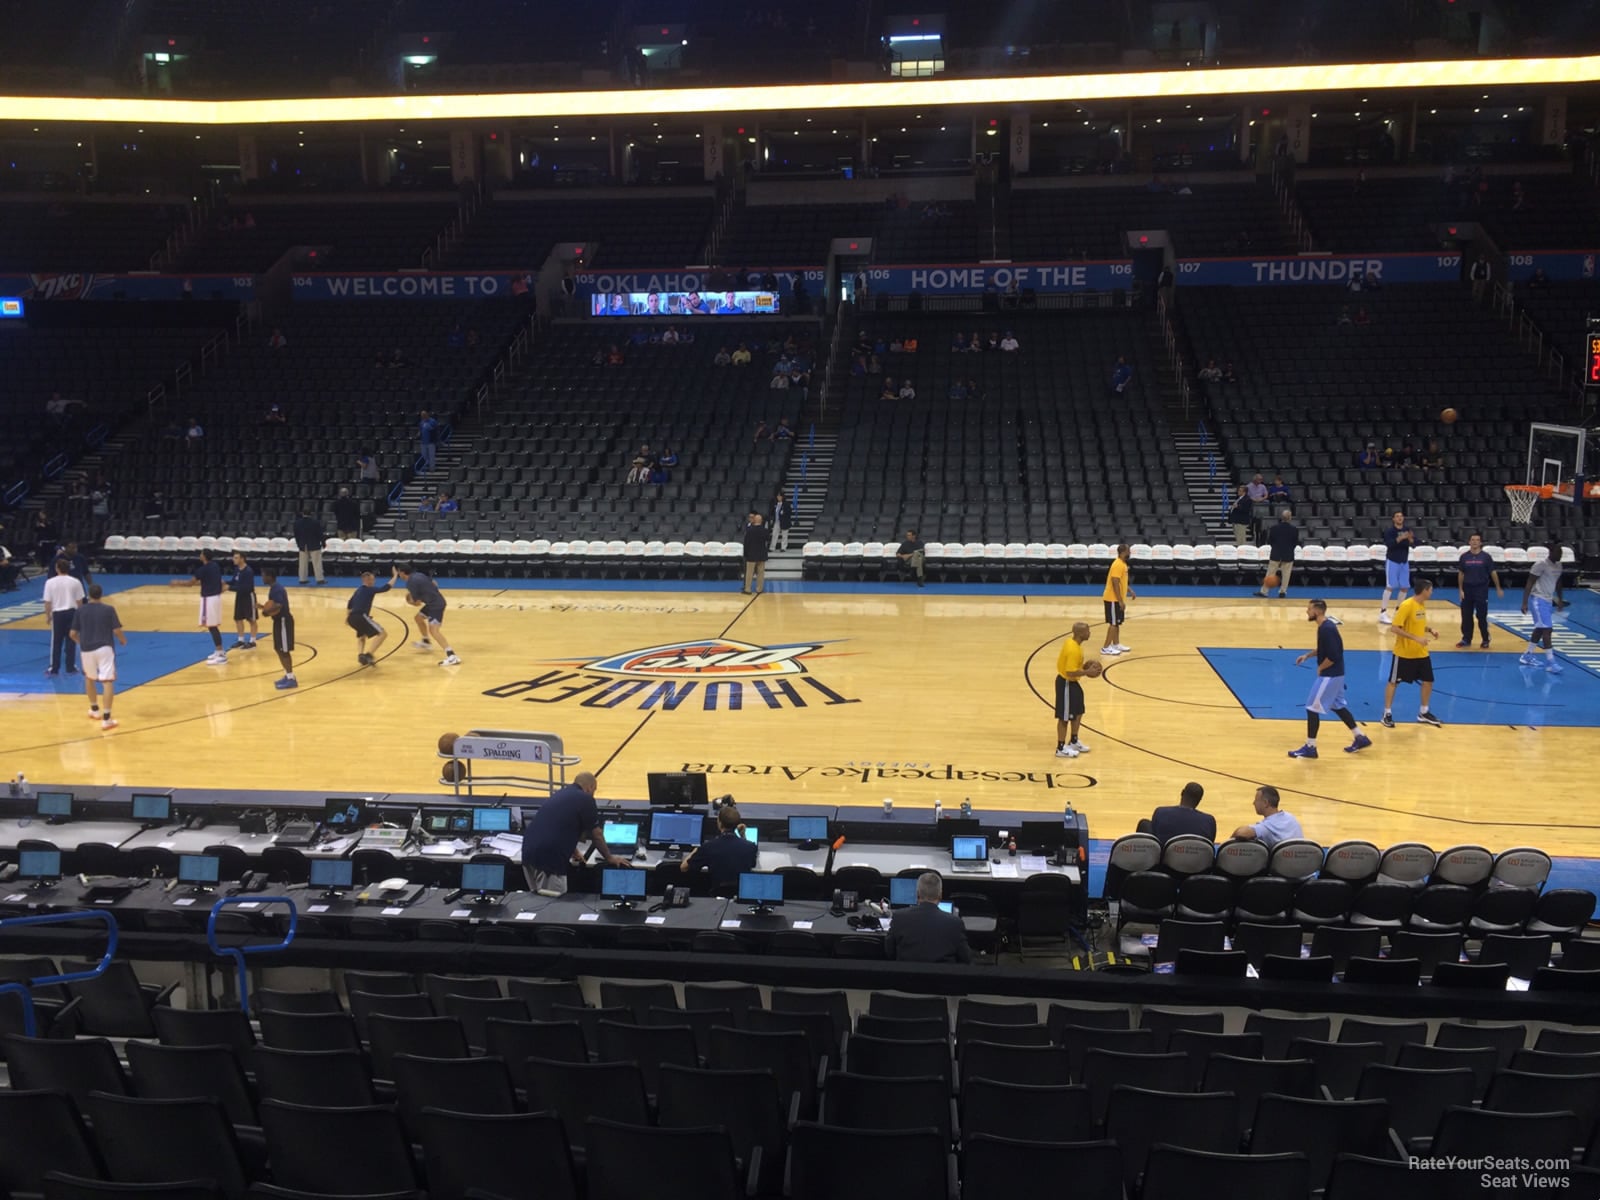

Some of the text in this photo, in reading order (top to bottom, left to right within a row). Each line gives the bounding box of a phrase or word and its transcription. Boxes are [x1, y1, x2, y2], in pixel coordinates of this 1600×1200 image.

[1438, 257, 1461, 267] 107
[1510, 255, 1533, 266] 108
[1110, 264, 1132, 275] 106
[1179, 263, 1201, 273] 107
[1251, 259, 1384, 281] THUNDER
[576, 274, 595, 284] 105
[803, 271, 824, 281] 105
[868, 270, 890, 280] 106
[911, 266, 1087, 289] HOME OF THE
[233, 277, 253, 287] 103
[293, 277, 313, 287] 104
[326, 276, 456, 296] WELCOME
[464, 276, 498, 295] TO
[482, 669, 862, 712] THUNDER
[482, 747, 521, 759] SPALDING
[681, 761, 1098, 790] Chesapeake Arena
